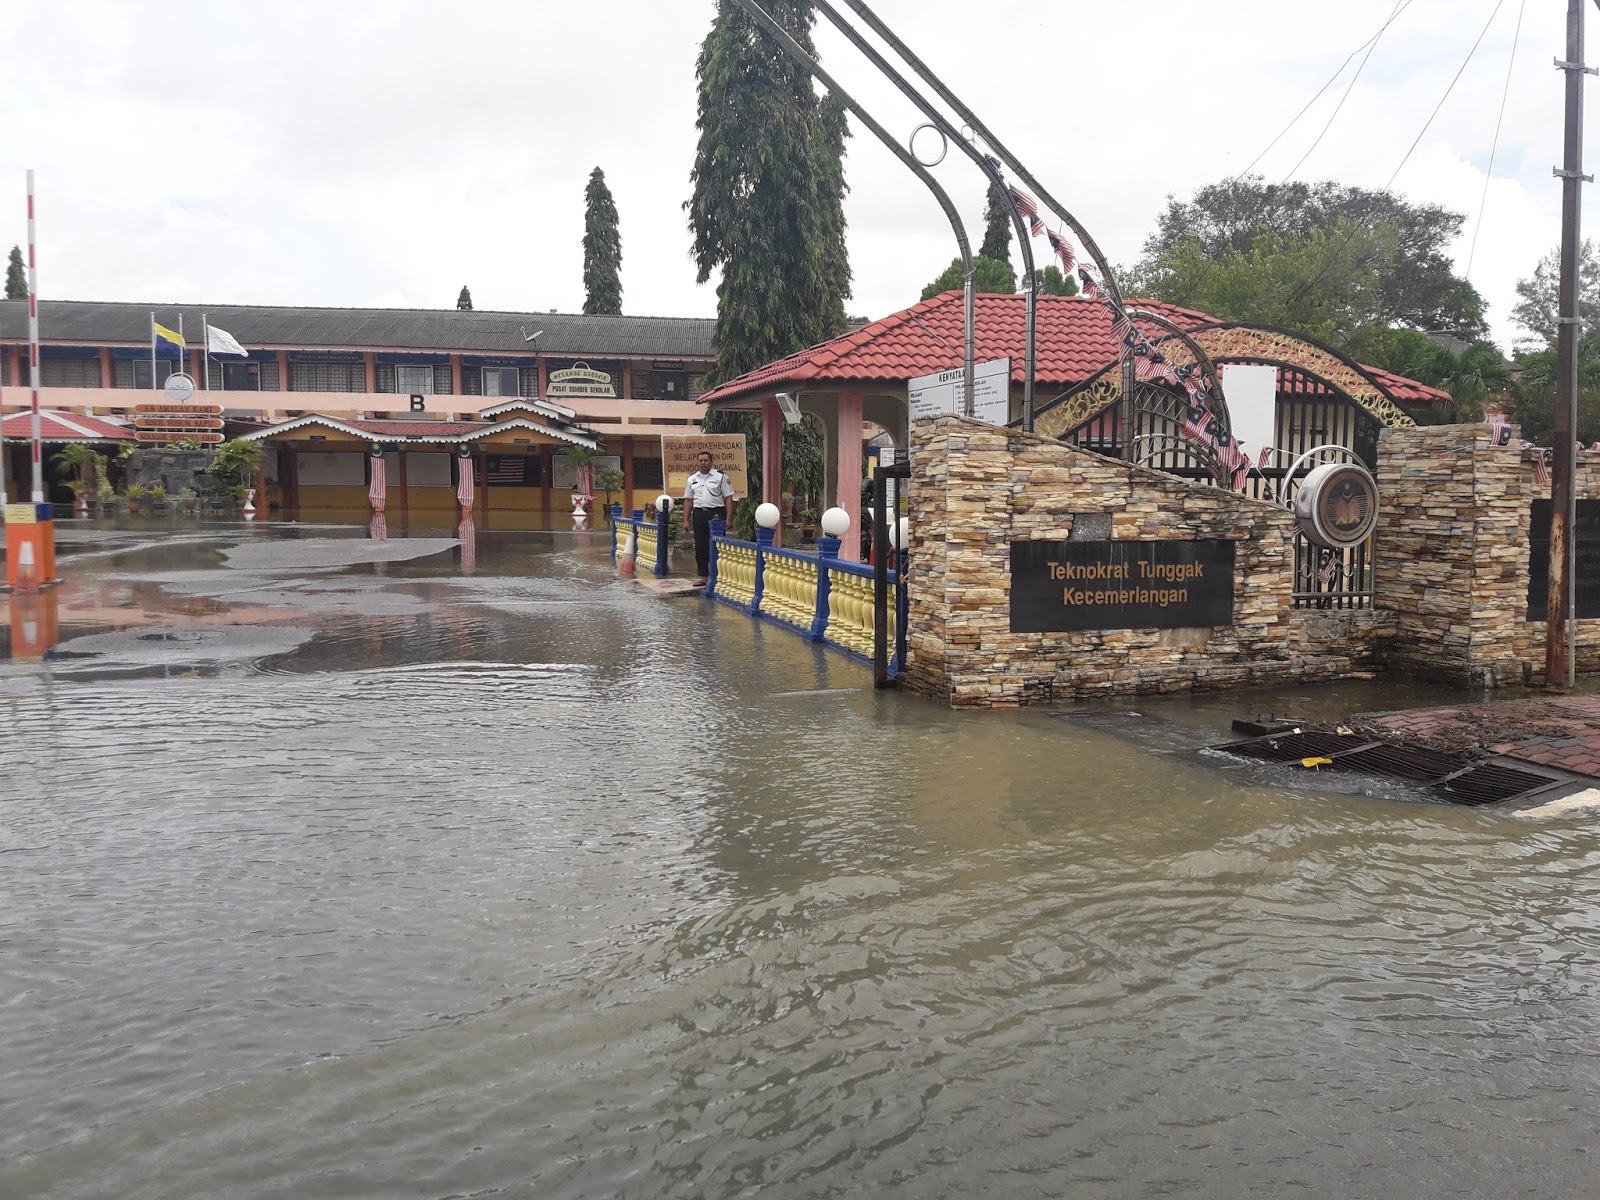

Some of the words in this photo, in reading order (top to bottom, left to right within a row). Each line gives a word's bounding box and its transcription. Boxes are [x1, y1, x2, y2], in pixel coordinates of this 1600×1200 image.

[939, 369, 965, 383] KENYATAA
[552, 385, 567, 393] PUSAT
[590, 386, 610, 394] SEKOLAH
[410, 394, 425, 412] B
[666, 442, 697, 450] PELAWAT
[676, 464, 699, 472] PONDO
[1048, 562, 1129, 579] Teknokrat
[1138, 561, 1204, 582] Tunggak
[1064, 587, 1188, 607] Kecemerlangan
